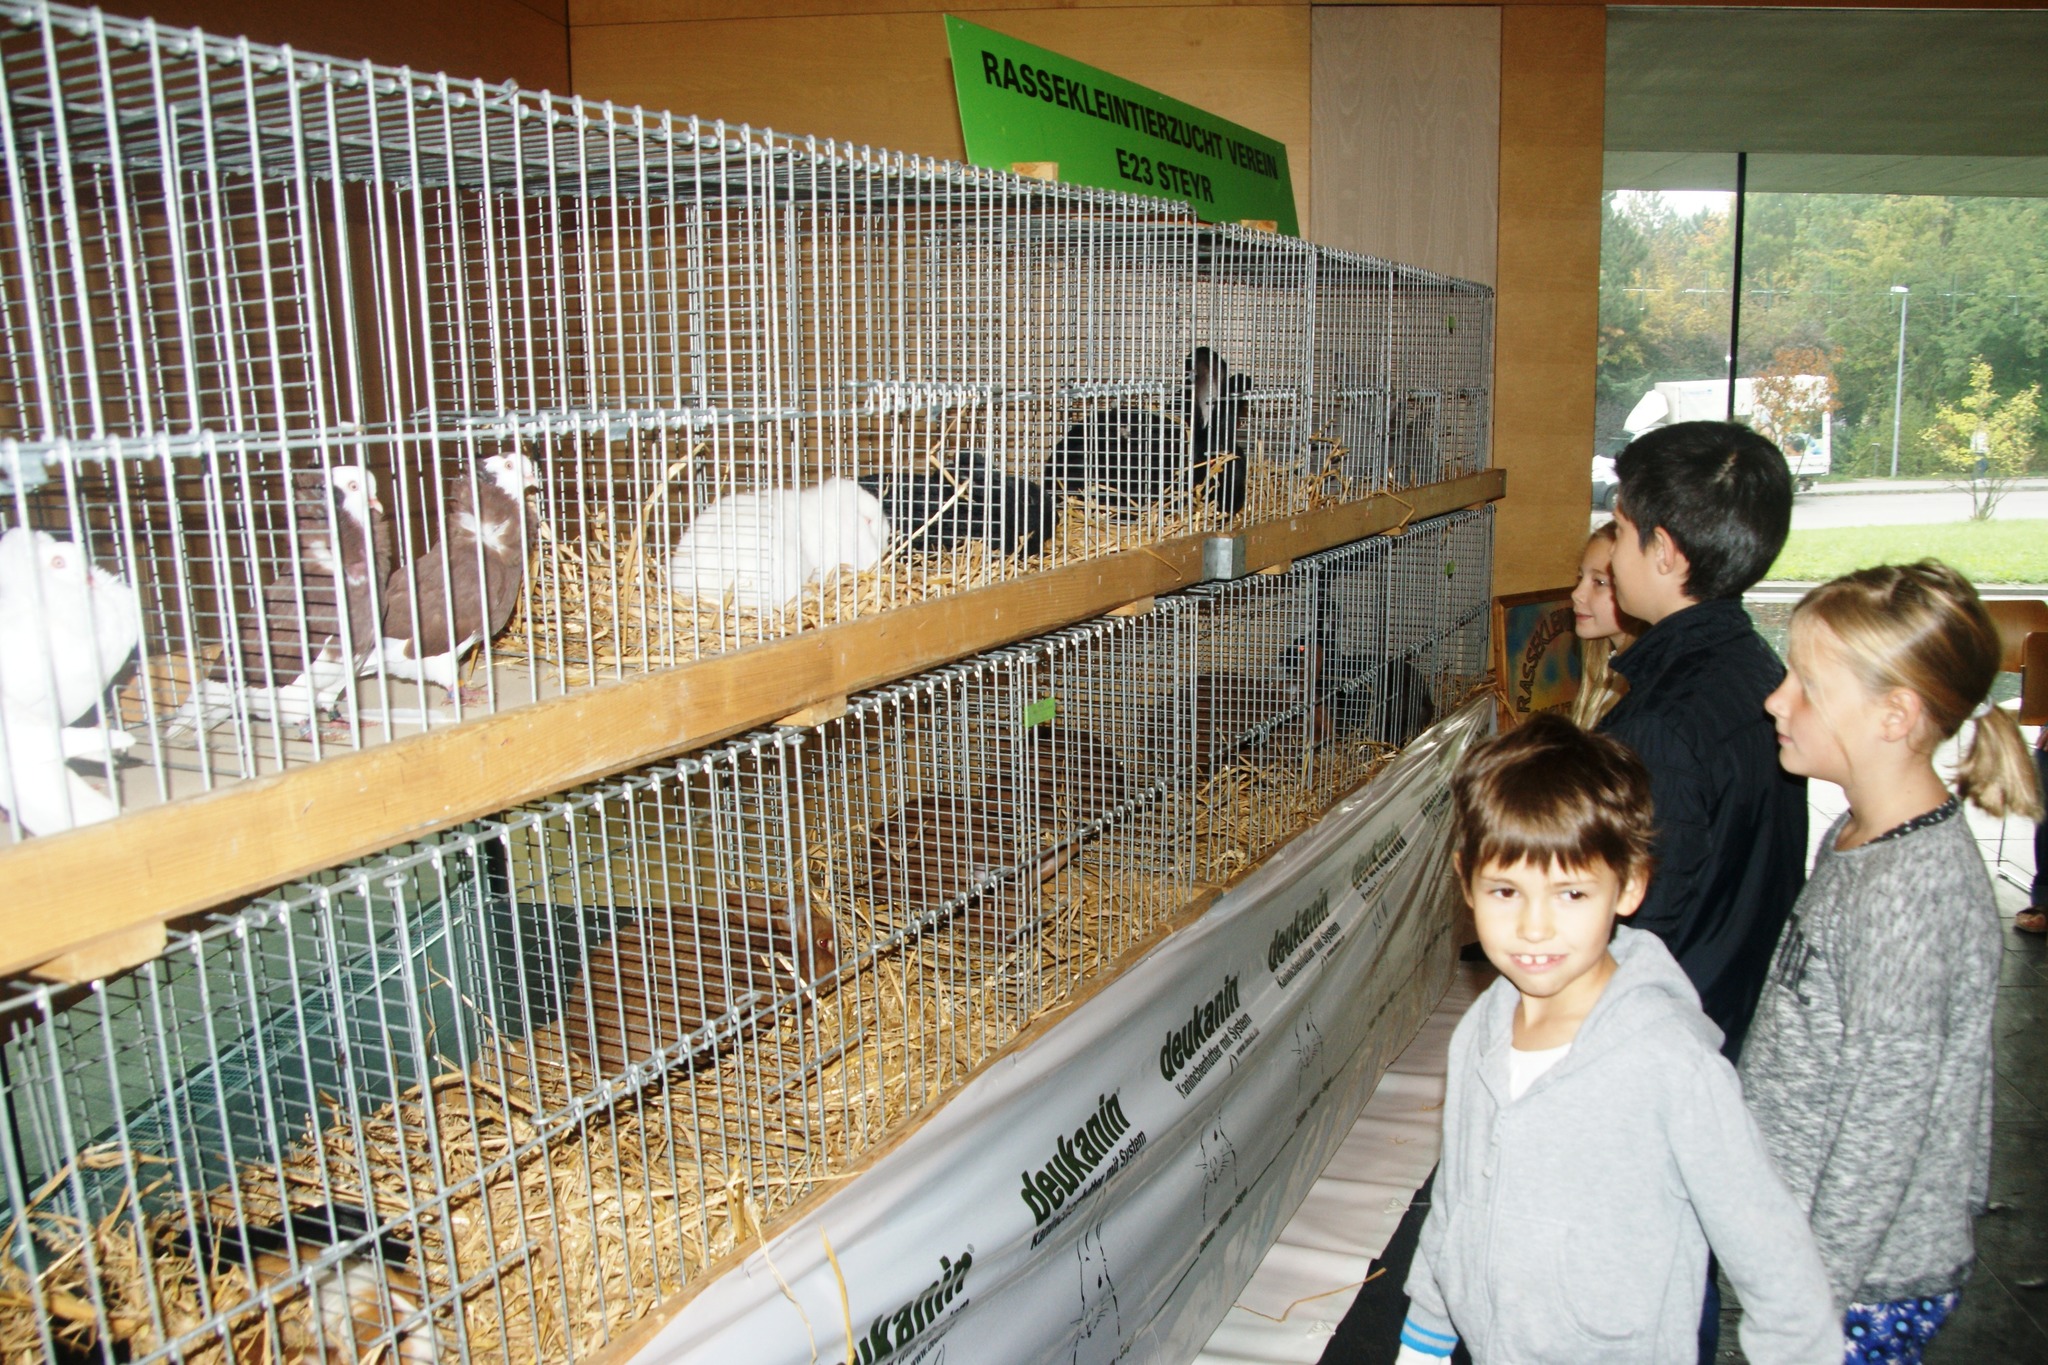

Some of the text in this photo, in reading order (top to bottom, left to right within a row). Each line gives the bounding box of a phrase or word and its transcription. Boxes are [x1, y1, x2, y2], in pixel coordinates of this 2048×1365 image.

[981, 50, 1279, 181] RASSEKLEINTIERZUCHT VEREIN
[1115, 147, 1215, 204] E23 STEYR
[1268, 887, 1330, 973] deukanin
[1160, 974, 1241, 1082] deukanin
[1175, 1012, 1253, 1100] Kaninchenfutter mit System
[1020, 1092, 1132, 1227] deukanin
[1118, 1130, 1147, 1168] System
